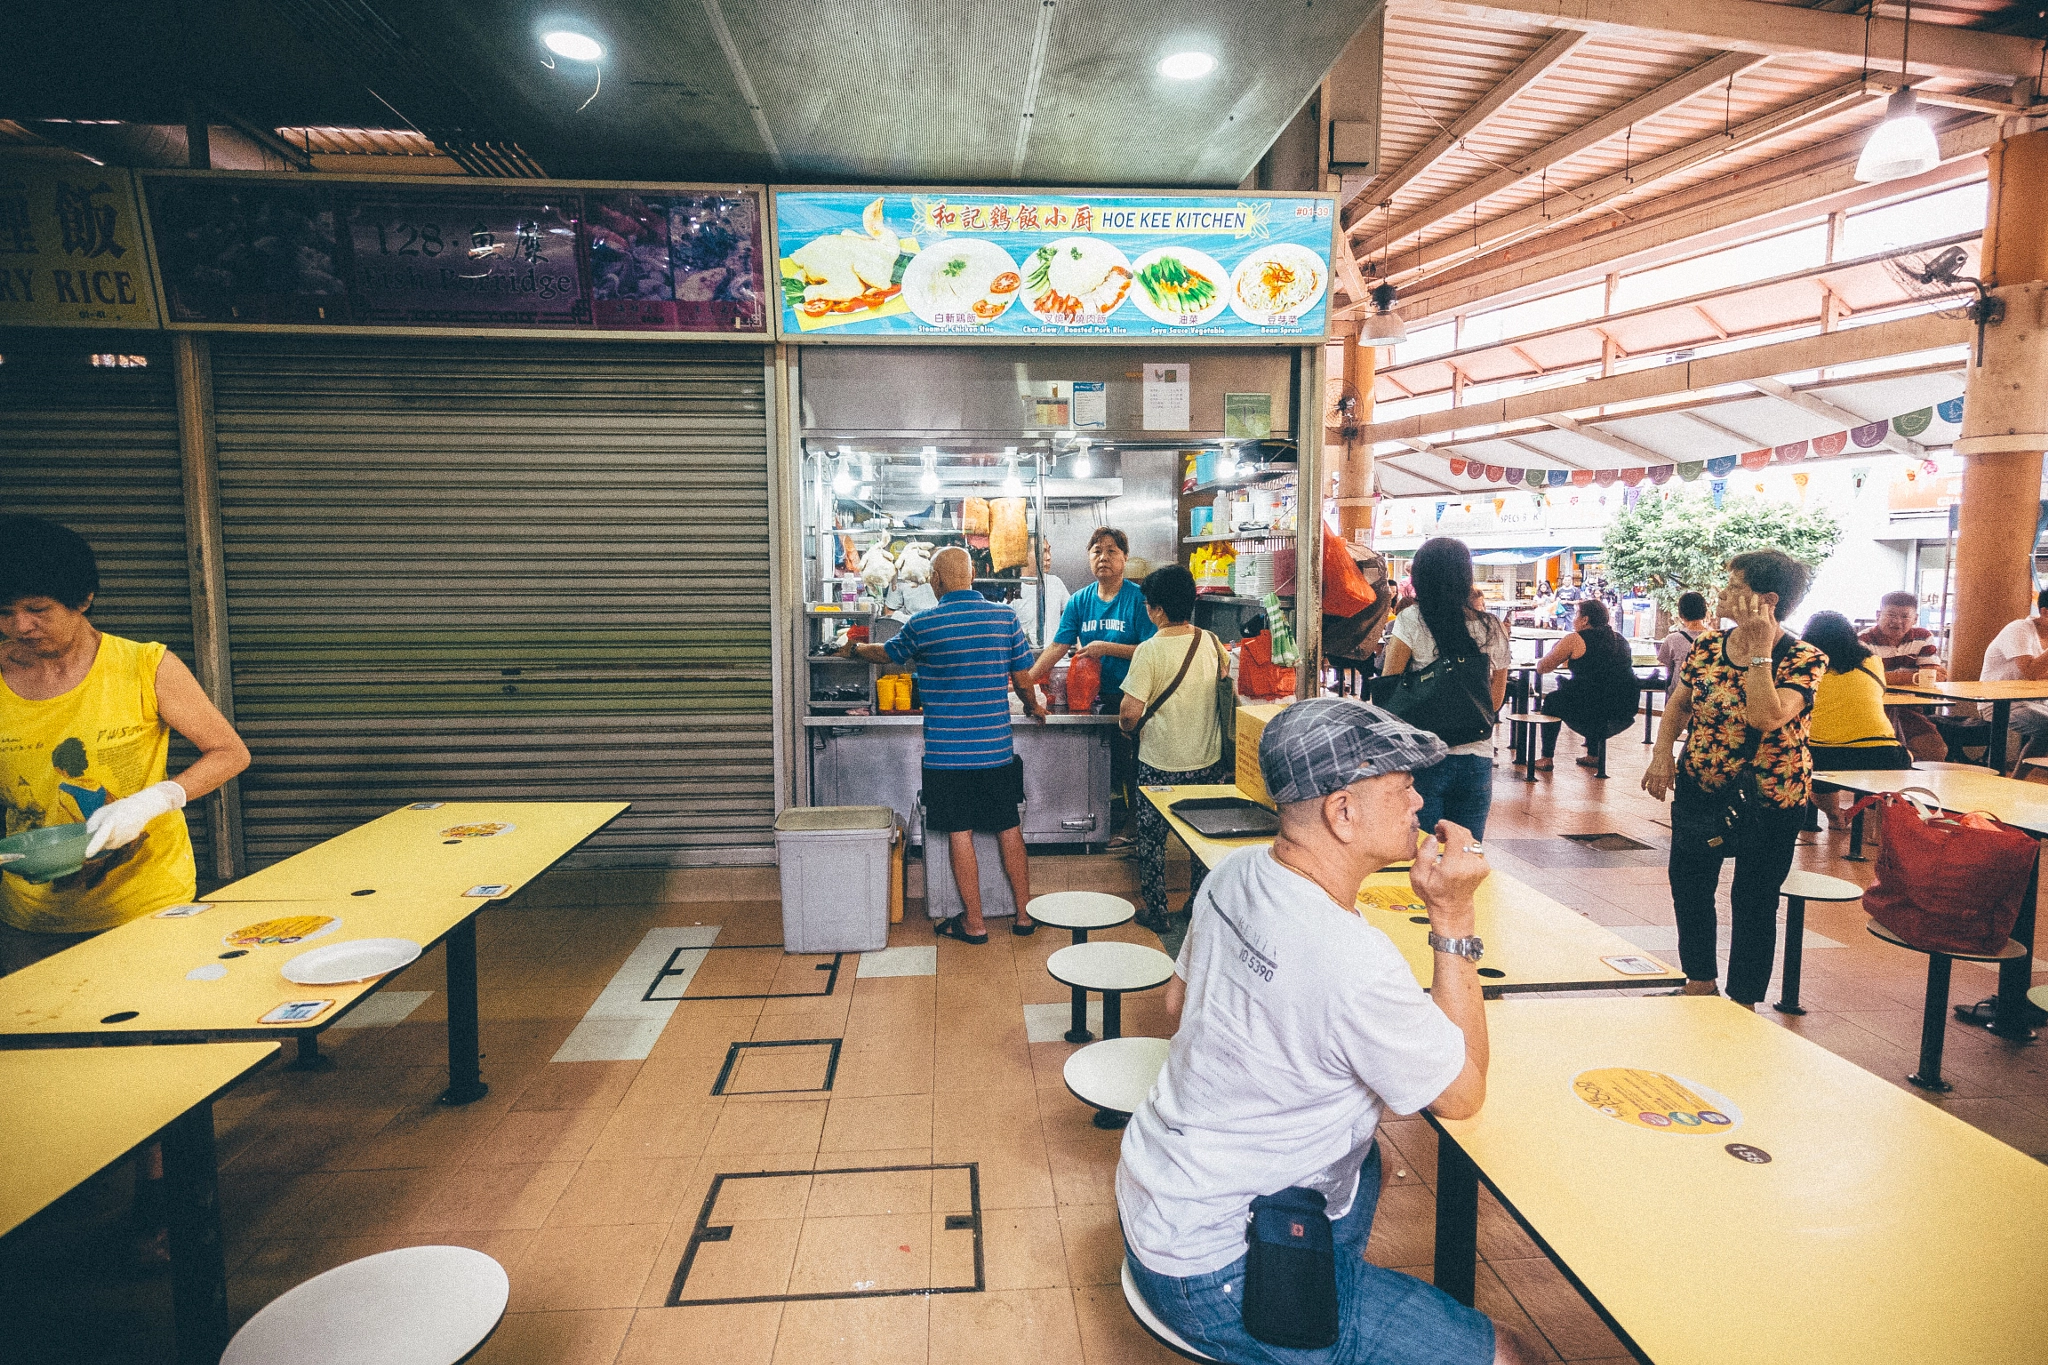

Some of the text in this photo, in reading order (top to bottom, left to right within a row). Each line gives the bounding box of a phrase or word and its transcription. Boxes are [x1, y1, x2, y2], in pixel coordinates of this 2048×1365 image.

[1295, 207, 1329, 217] #01-39
[1102, 212, 1247, 229] HOE KEE KITCHEN
[52, 269, 136, 305] RICE
[438, 267, 571, 300] Porridge
[1178, 315, 1198, 324] 油菜
[918, 325, 994, 333] Steamed Chicken Rice
[1094, 326, 1111, 334] Pork
[1113, 326, 1127, 334] Rice
[1151, 327, 1167, 335] Soya
[1190, 327, 1225, 335] Vegetable
[1280, 327, 1303, 335] Sprout
[1081, 618, 1125, 633] AIR FORCE
[1247, 956, 1274, 982] 5390
[1732, 1145, 1765, 1164] 158
